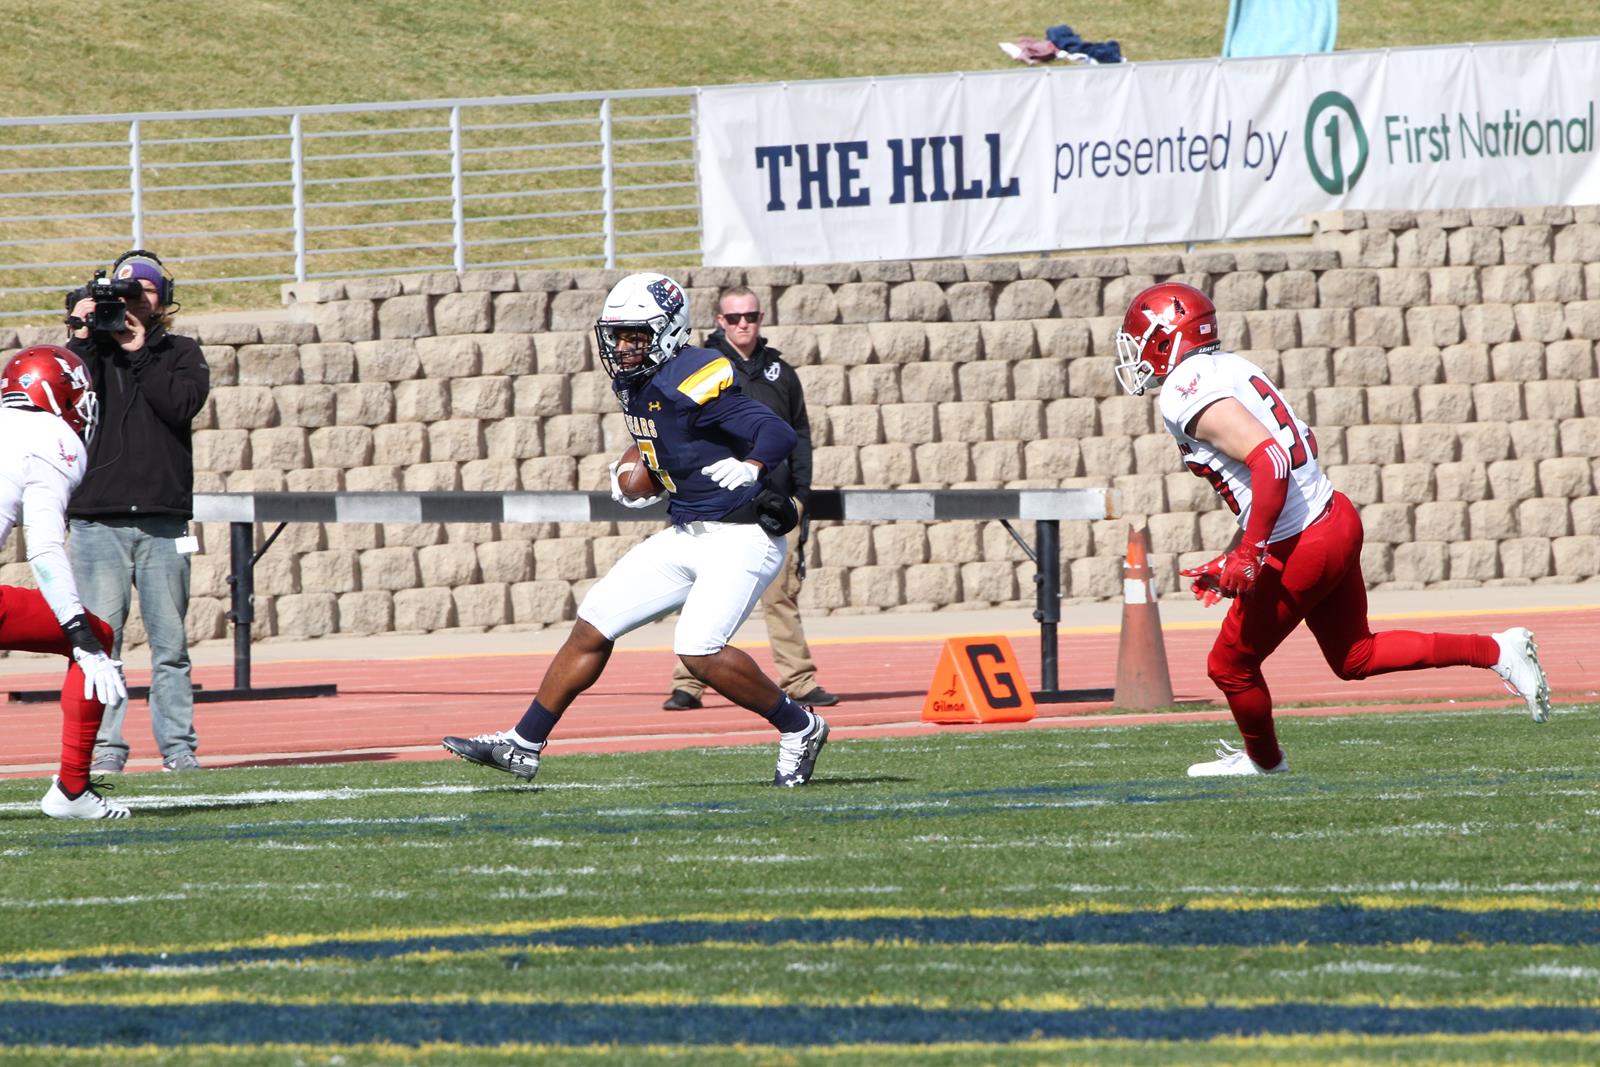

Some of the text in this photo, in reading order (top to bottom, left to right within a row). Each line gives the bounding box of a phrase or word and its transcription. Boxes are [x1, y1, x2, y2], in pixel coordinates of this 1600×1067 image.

[1053, 119, 1288, 194] presented by
[1384, 101, 1594, 164] First National
[755, 133, 1021, 212] THE HILL
[932, 700, 966, 712] Gilman
[965, 643, 1022, 710] G
